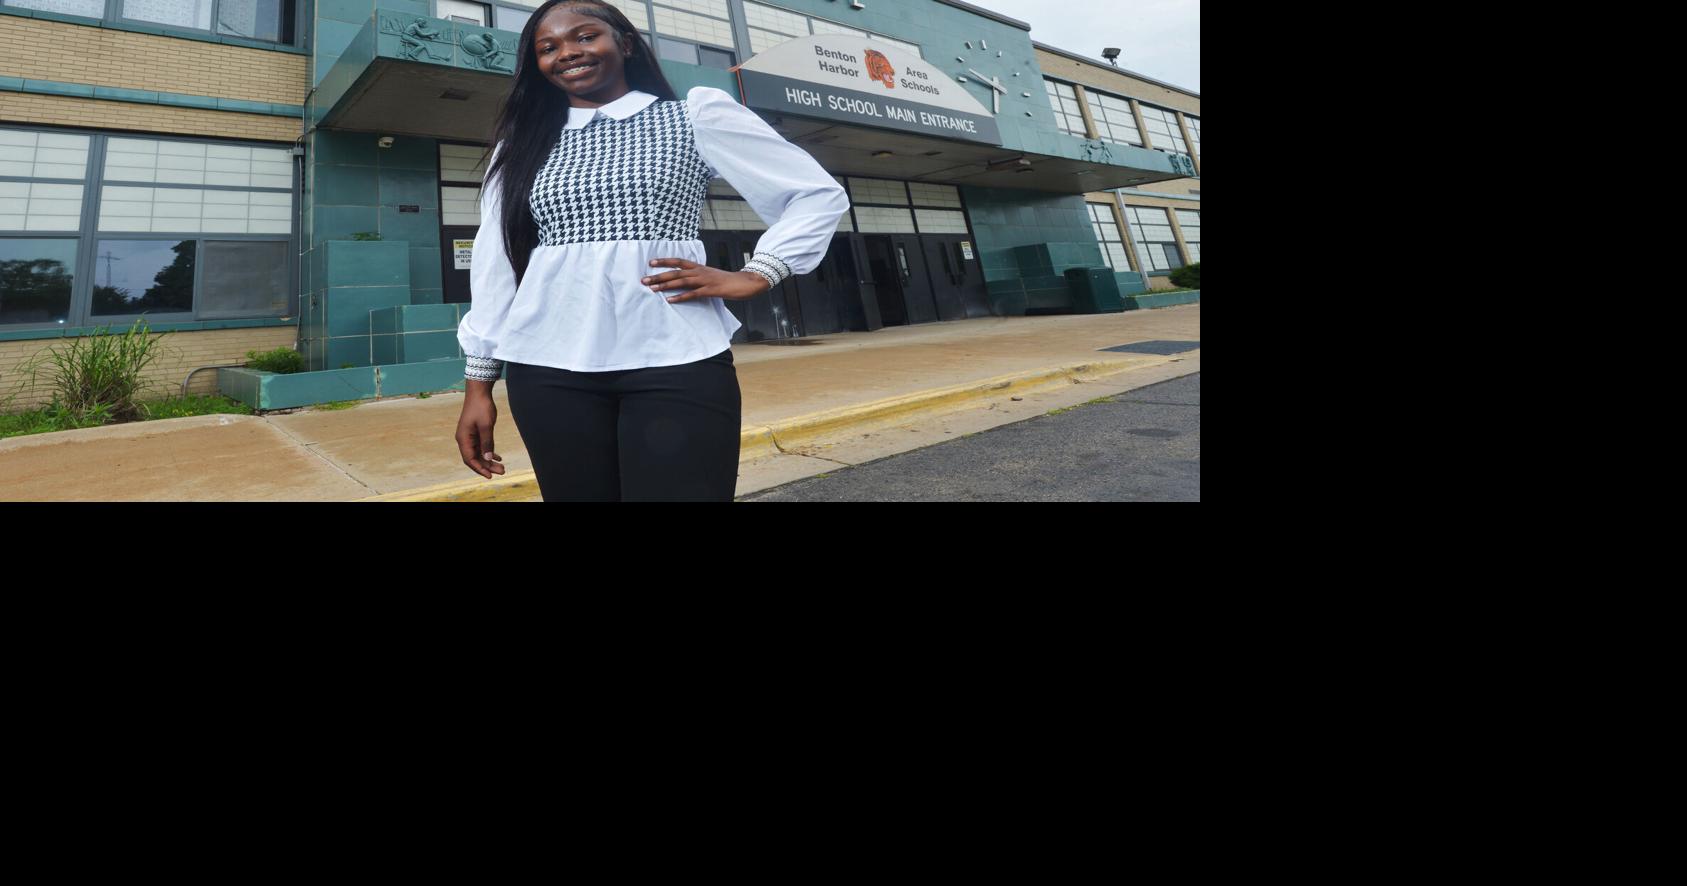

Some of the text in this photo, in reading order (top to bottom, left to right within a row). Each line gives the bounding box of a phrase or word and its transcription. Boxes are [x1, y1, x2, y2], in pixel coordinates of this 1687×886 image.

[815, 45, 856, 63] Benton
[819, 60, 859, 77] Harbor
[906, 66, 928, 80] Area
[901, 79, 939, 95] Schools
[785, 87, 976, 133] HIGH SCHOOL MAIN ENTRANCE
